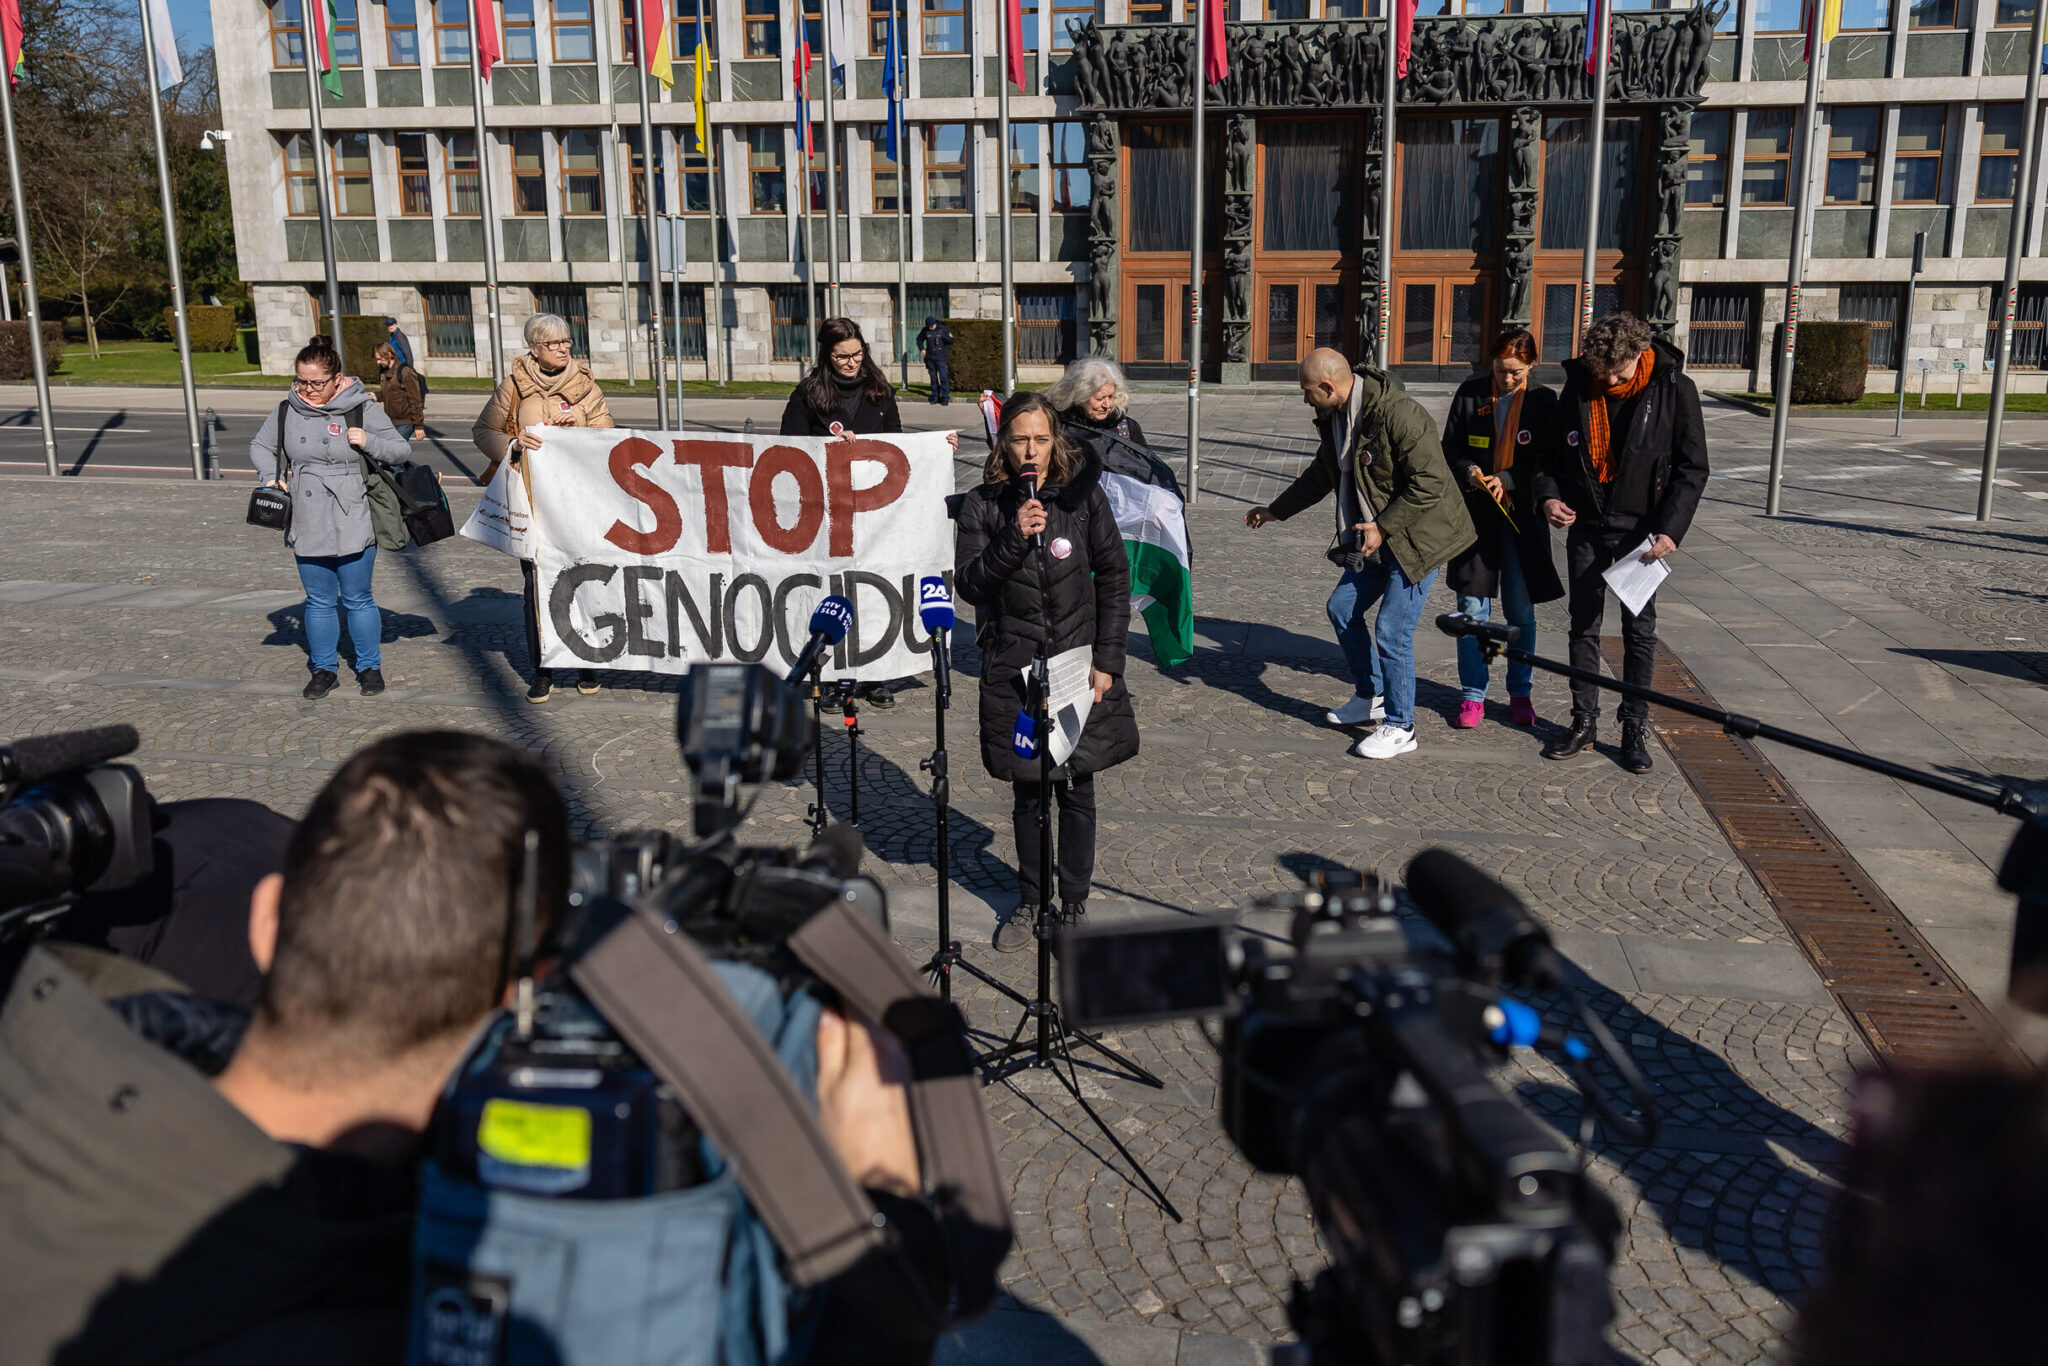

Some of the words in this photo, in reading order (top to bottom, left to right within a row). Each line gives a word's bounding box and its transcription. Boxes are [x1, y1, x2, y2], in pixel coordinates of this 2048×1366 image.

[604, 437, 911, 557] STOP
[256, 498, 284, 510] MIPRO
[824, 601, 841, 609] RTV
[548, 563, 953, 670] GENOCIDU
[820, 607, 837, 616] SLO
